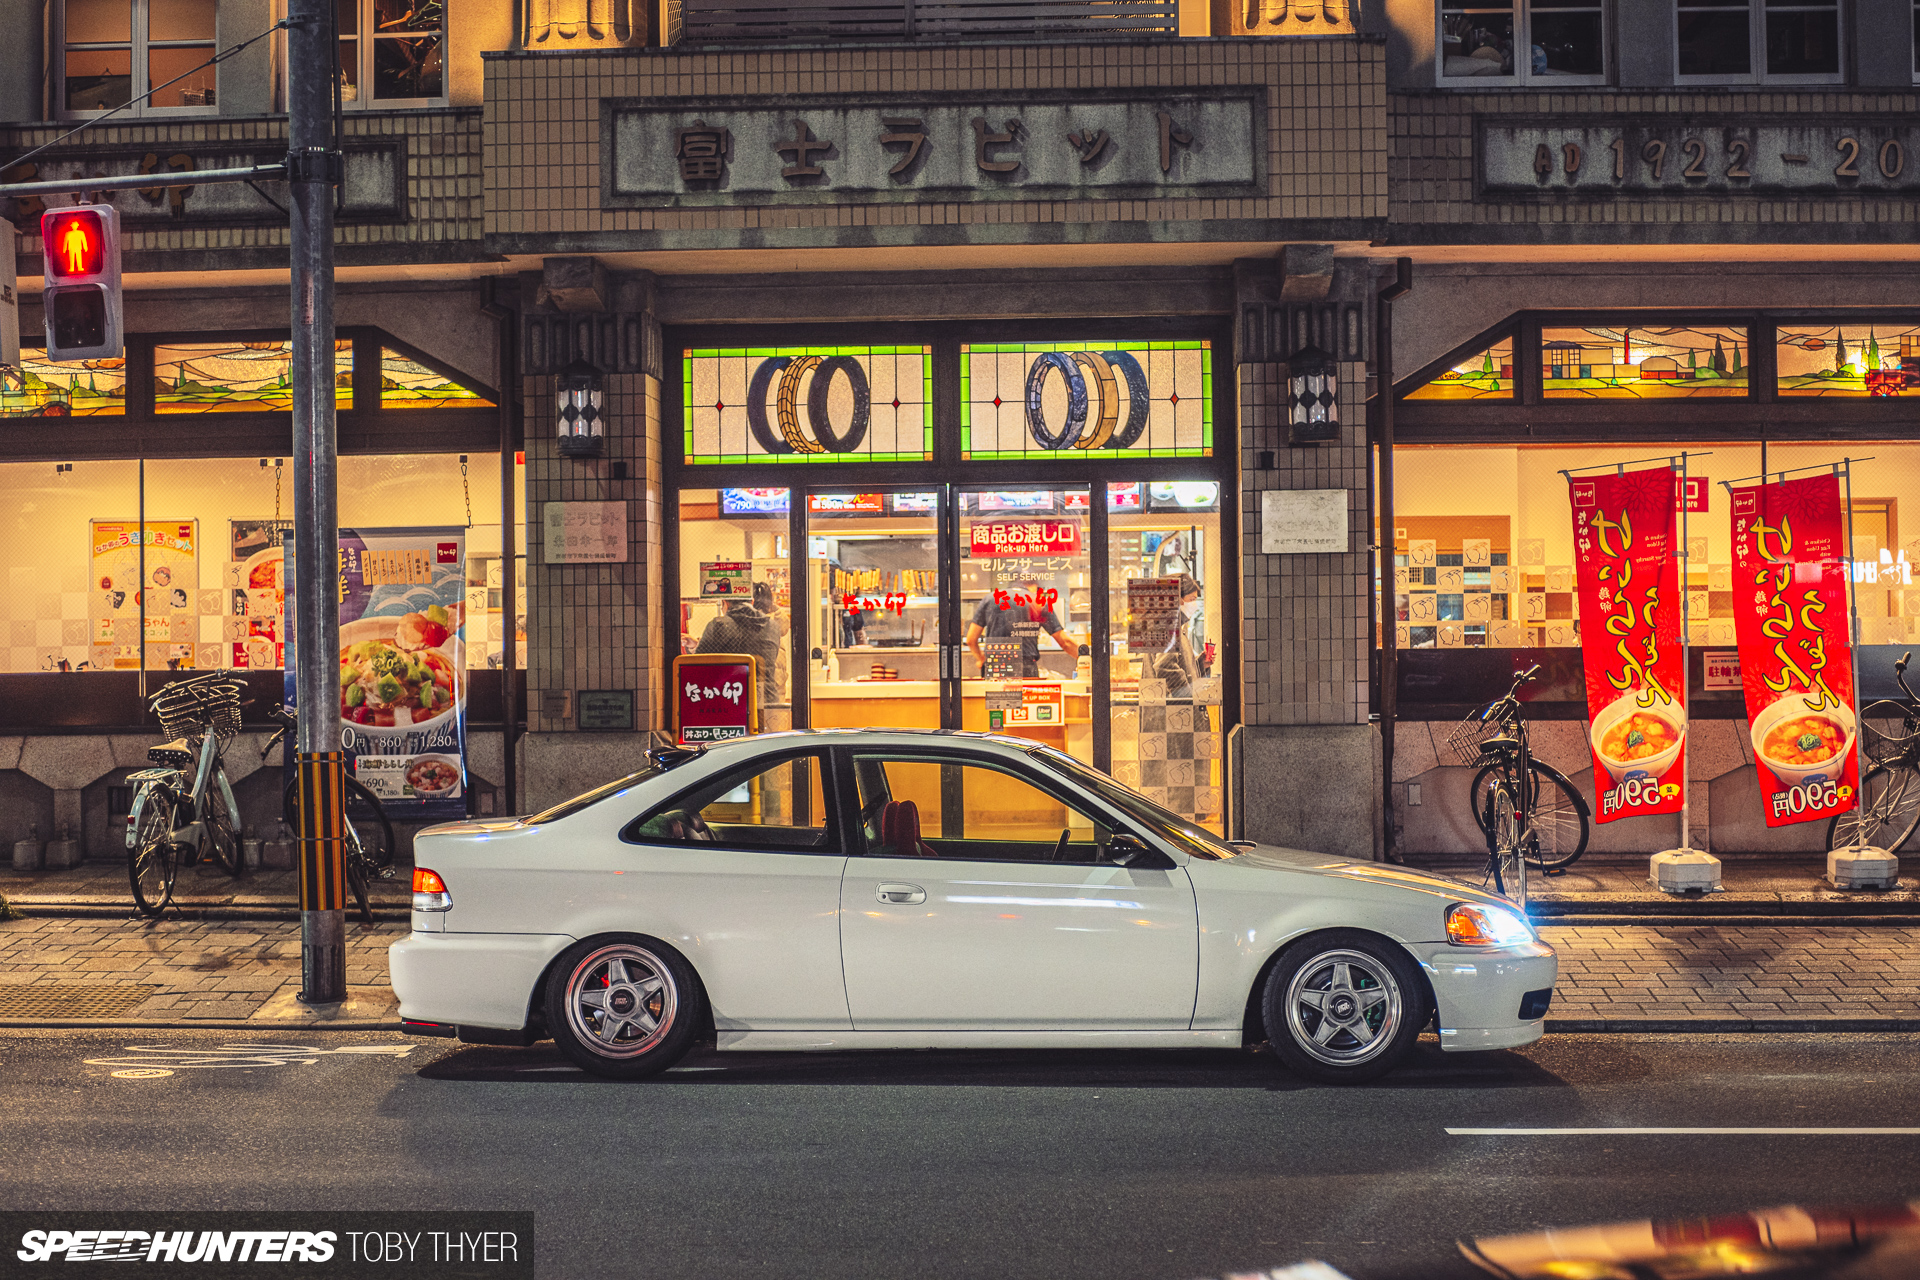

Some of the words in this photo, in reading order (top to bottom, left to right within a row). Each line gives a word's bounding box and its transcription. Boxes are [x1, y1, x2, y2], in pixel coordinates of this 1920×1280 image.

[664, 112, 1194, 180] 富士ラビット
[1534, 142, 1581, 174] AD
[1611, 138, 1751, 179] 1922
[1835, 137, 1902, 179] 20
[973, 523, 1074, 545] 商品お渡し口
[995, 544, 1027, 553] Pick-up
[1029, 543, 1049, 552] Here
[980, 557, 1073, 571] セルフサービス
[997, 573, 1018, 581] SELF
[1020, 572, 1055, 580] SERVICE
[842, 592, 907, 619] なか卯
[993, 587, 1059, 614] なか卯
[685, 681, 743, 706] なか卯
